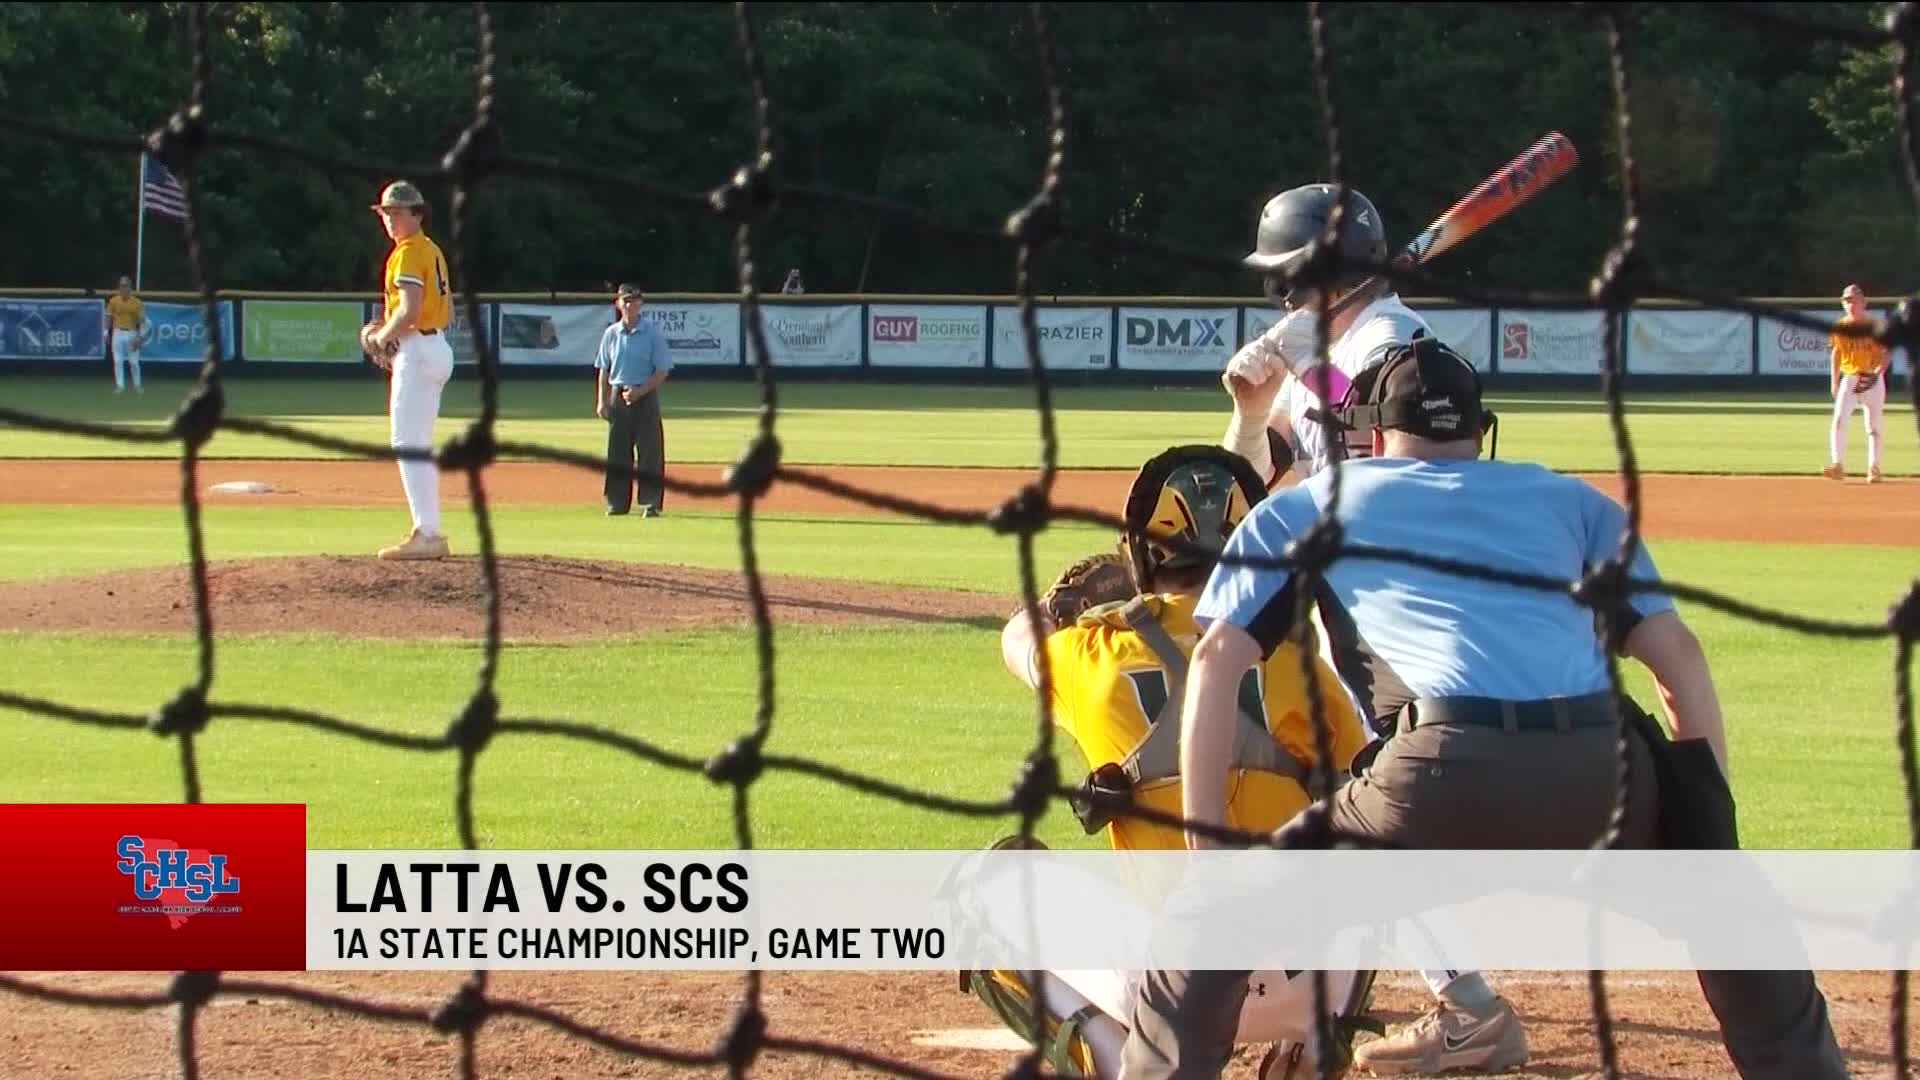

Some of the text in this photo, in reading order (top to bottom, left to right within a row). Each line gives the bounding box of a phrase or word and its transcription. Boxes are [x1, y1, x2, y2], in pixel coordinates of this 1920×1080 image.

[641, 311, 688, 321] FIRST
[875, 320, 981, 337] GUY ROOFING
[1037, 326, 1104, 341] RAZIER
[1126, 317, 1225, 347] DMX
